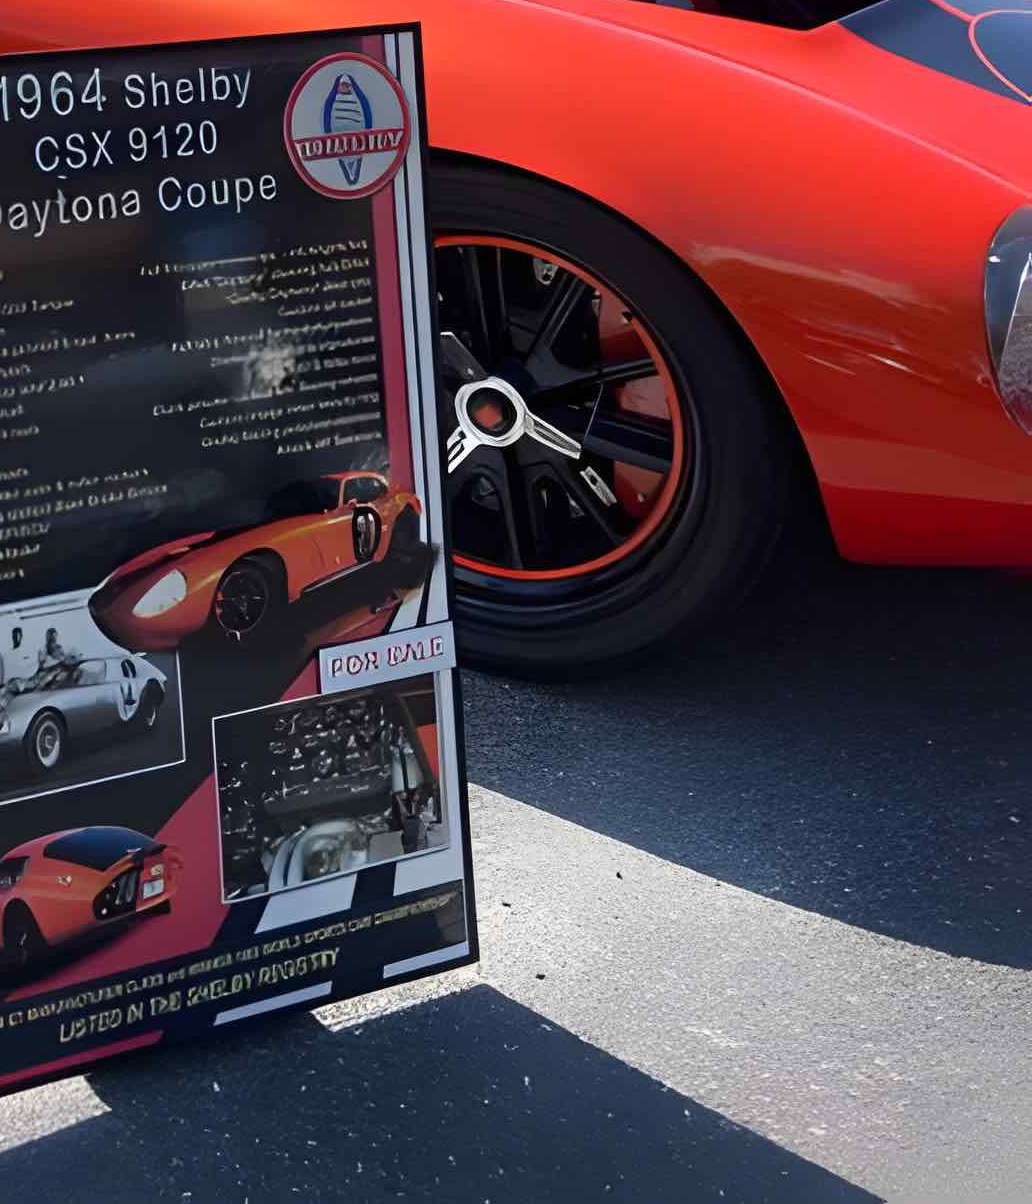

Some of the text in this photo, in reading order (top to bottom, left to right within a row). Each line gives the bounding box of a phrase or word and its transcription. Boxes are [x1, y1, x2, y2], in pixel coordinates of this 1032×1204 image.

[124, 67, 251, 109] Shelby
[35, 119, 218, 172] CSX 9120
[158, 174, 278, 214] Coupe
